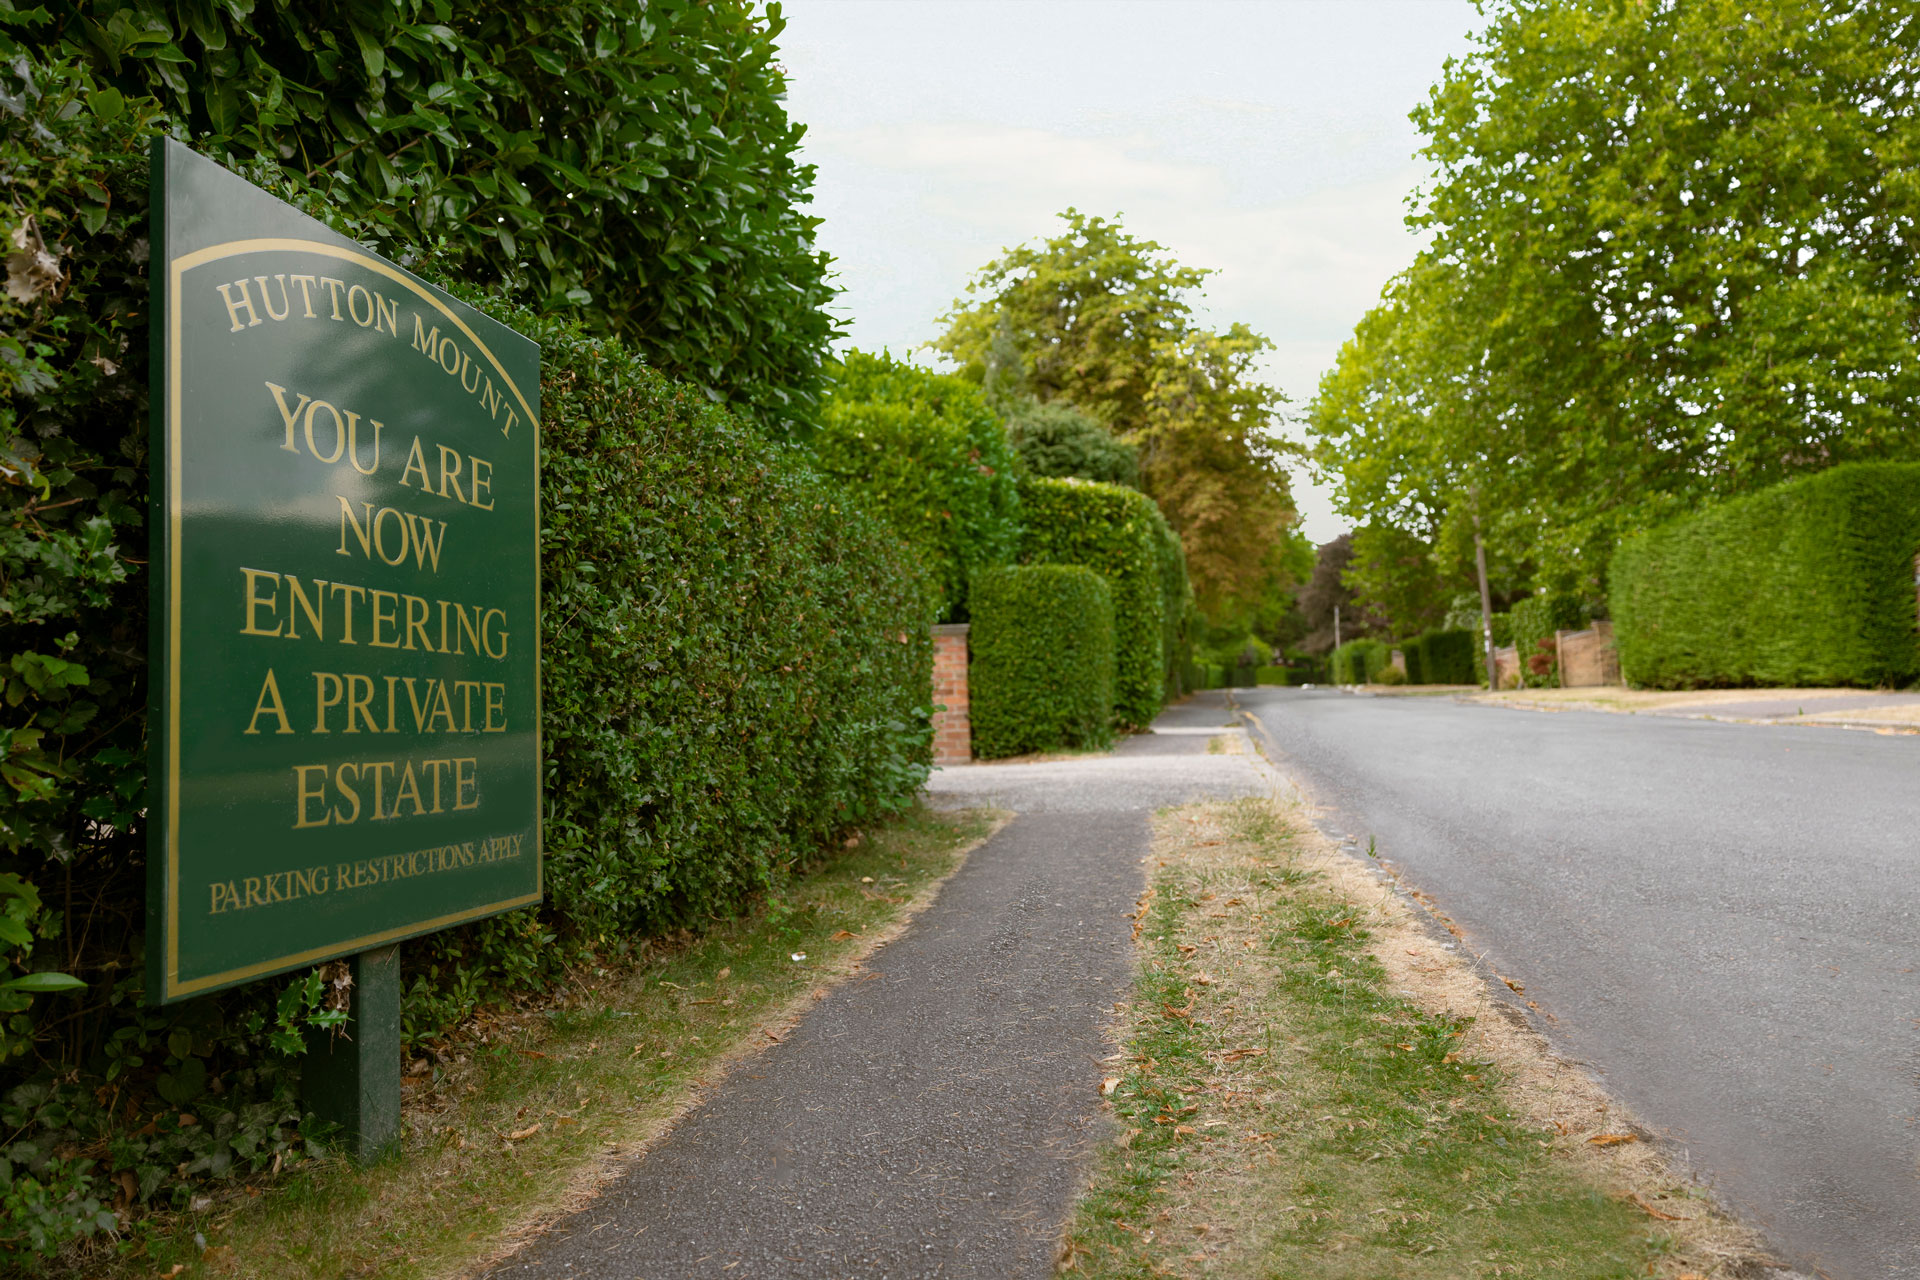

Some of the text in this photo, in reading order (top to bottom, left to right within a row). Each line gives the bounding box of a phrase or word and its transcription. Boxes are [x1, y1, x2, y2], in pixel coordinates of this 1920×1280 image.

[216, 274, 519, 440] HUTTON MOUNT
[265, 381, 495, 512] YOU ARE
[335, 495, 448, 573] NOW
[239, 567, 510, 660] ENTERING
[243, 668, 508, 734] A PRIVATE
[291, 757, 480, 829] ESTATE
[208, 834, 524, 915] PARKING RESTRICTIONS APPLY
